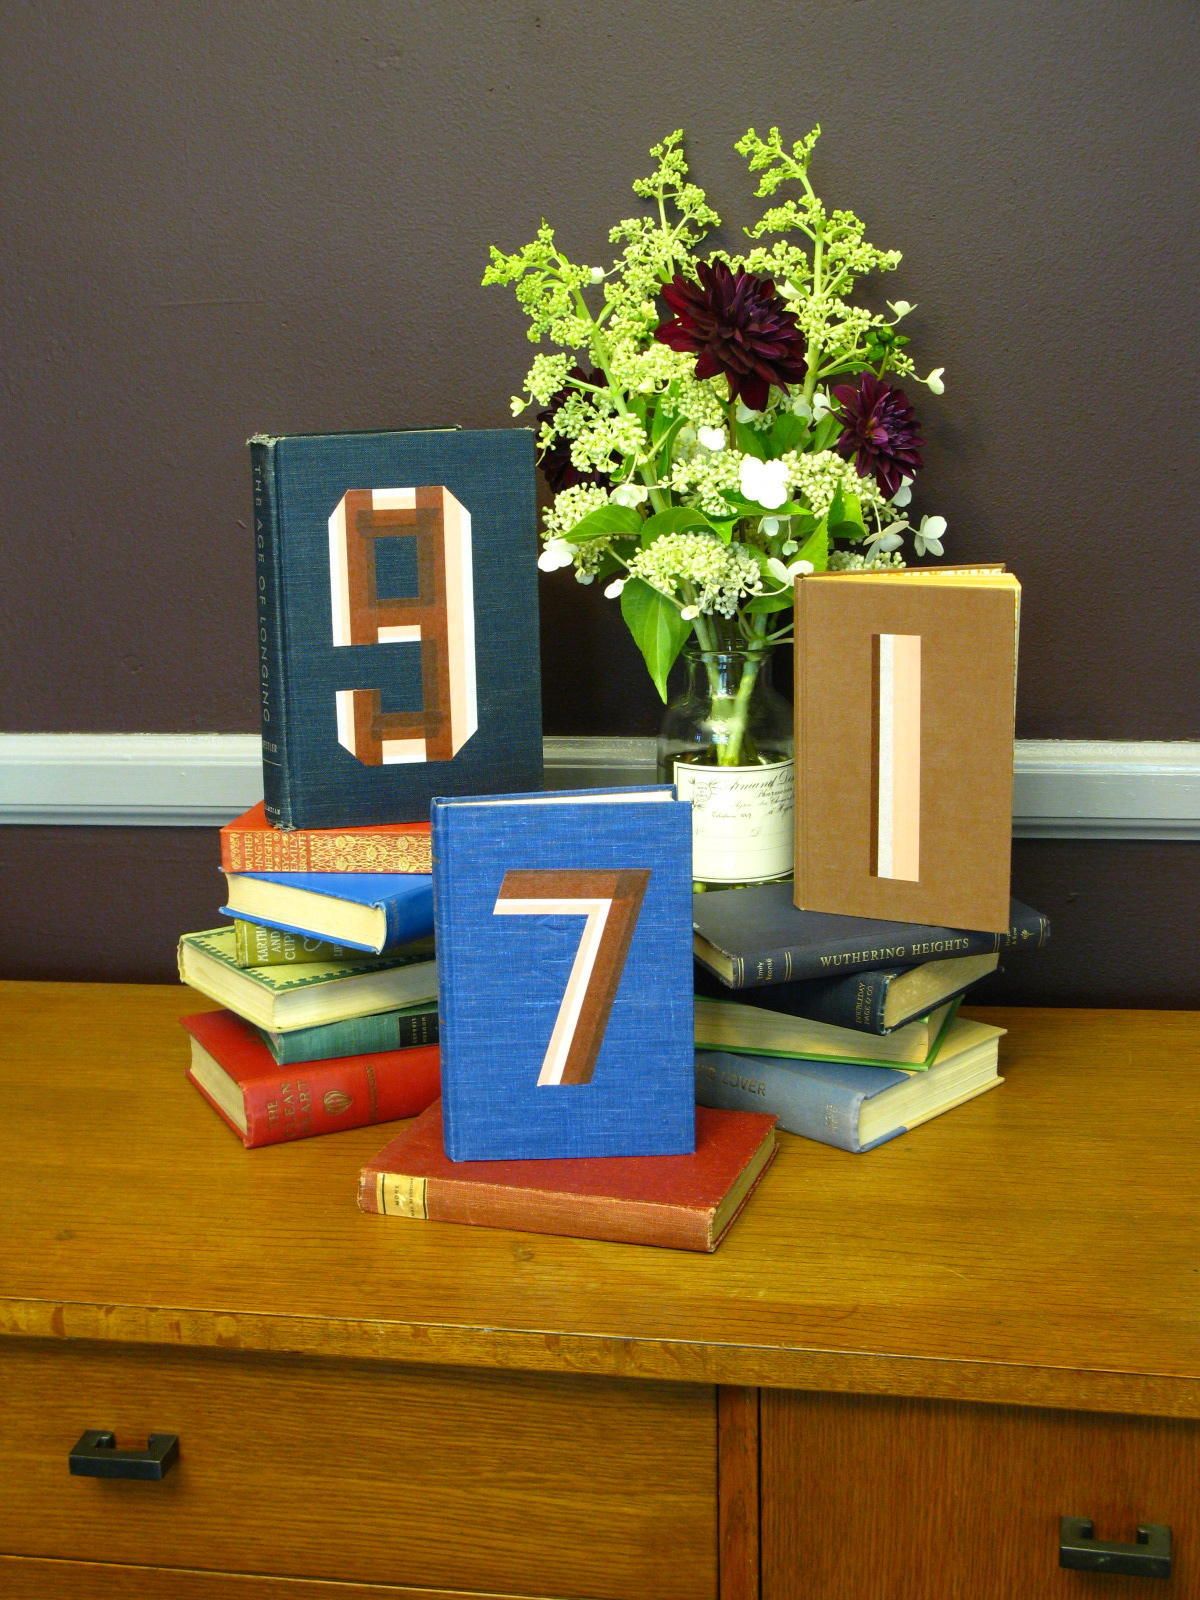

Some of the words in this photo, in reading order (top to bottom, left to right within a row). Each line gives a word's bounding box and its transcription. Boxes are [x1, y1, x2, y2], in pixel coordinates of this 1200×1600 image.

[253, 465, 263, 507] THE
[256, 518, 266, 563] AGE
[258, 575, 267, 606] OF
[327, 486, 479, 767] 9
[260, 616, 271, 723] LONGING
[263, 832, 273, 872] HEIGHTS
[290, 833, 298, 872] EMILY
[270, 931, 282, 953] AND
[819, 946, 906, 968] WUTHERING
[911, 937, 970, 956] HEIGHTS
[493, 868, 652, 1087] 7
[720, 1071, 767, 1098] LOVER
